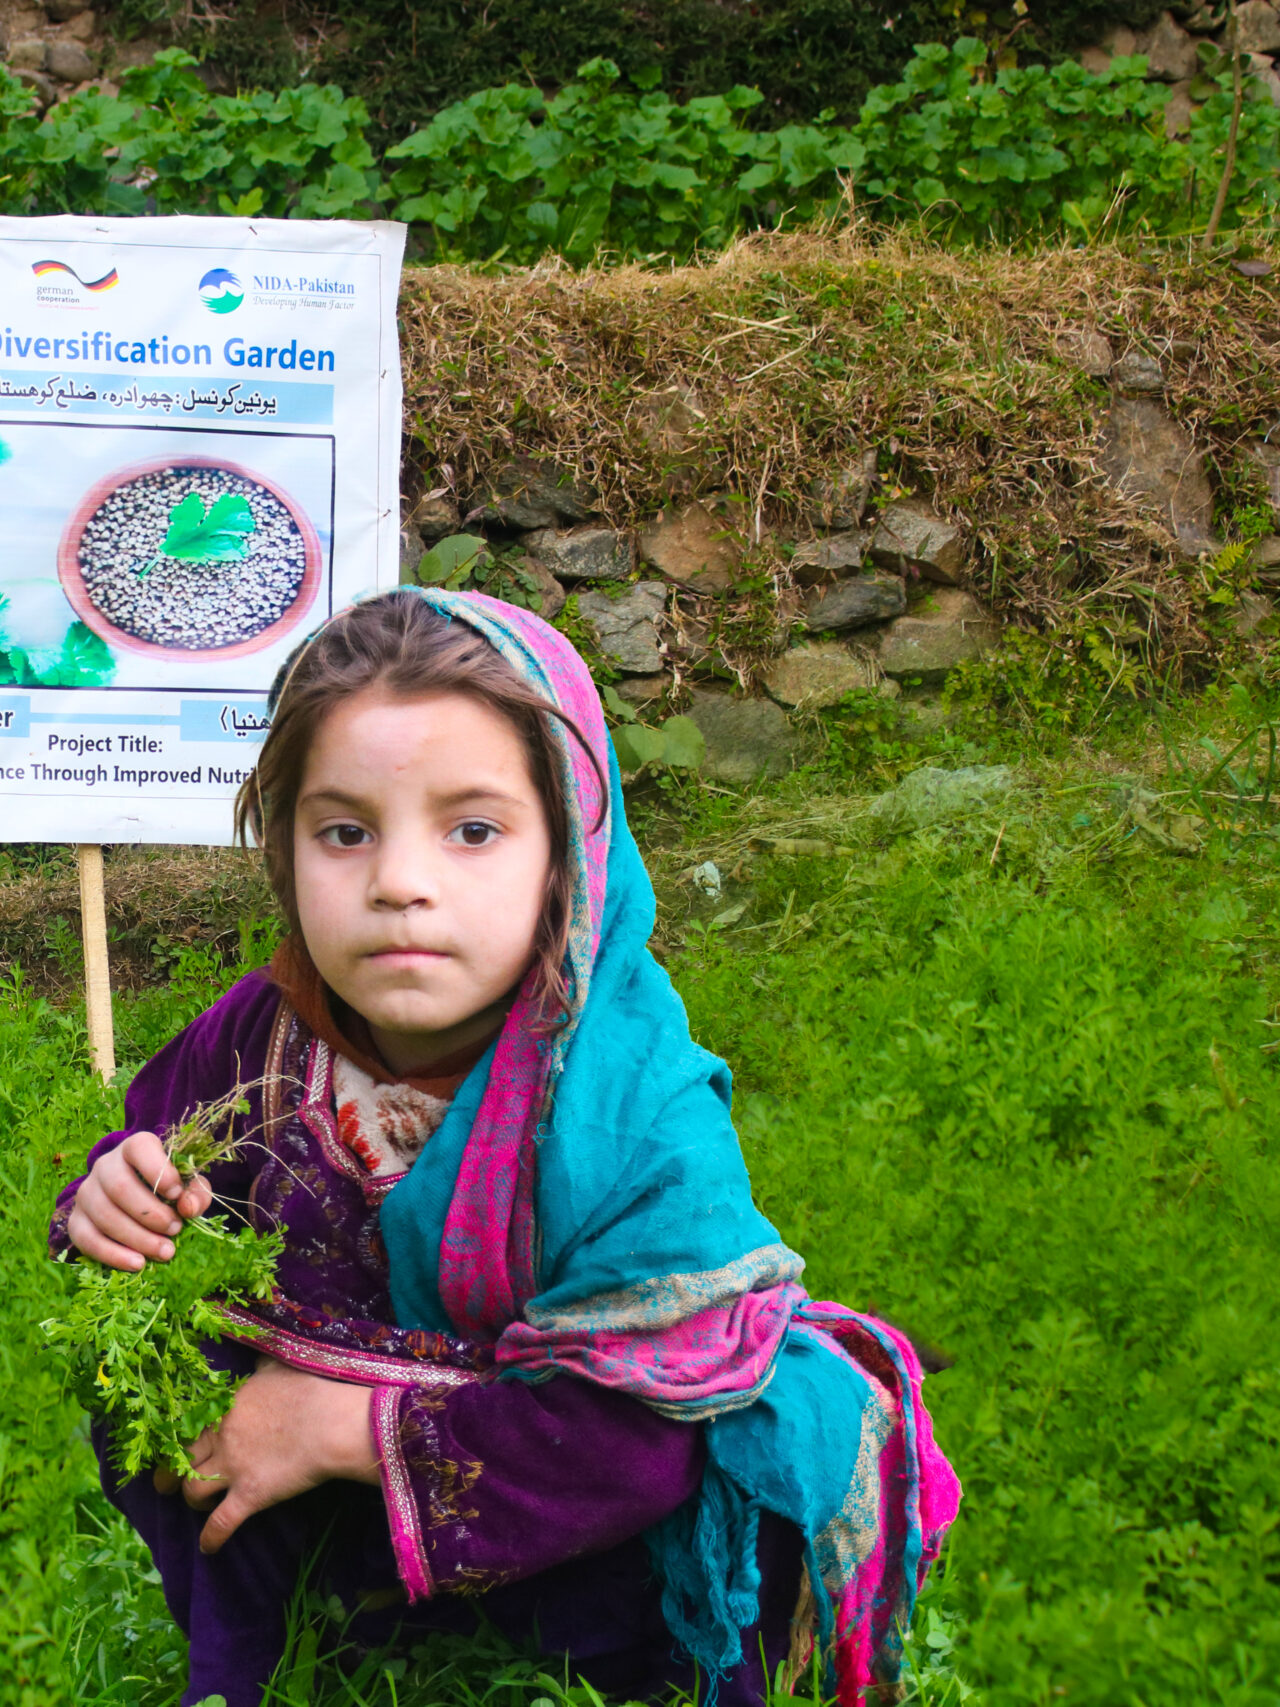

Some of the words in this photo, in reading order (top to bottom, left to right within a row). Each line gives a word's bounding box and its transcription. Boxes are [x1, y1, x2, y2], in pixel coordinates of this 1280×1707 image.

[36, 286, 74, 296] german
[253, 275, 355, 295] NIDA-Pakistan
[36, 296, 80, 304] cooperation
[253, 295, 297, 310] Developing
[299, 298, 327, 309] Human
[328, 301, 355, 310] Factor
[224, 337, 335, 371] Garden
[55, 380, 97, 408] ضلع
[48, 734, 112, 756] Project
[118, 735, 163, 753] Title:
[30, 763, 108, 786] Through
[114, 765, 201, 787] Improved
[209, 767, 254, 784] Nutr
